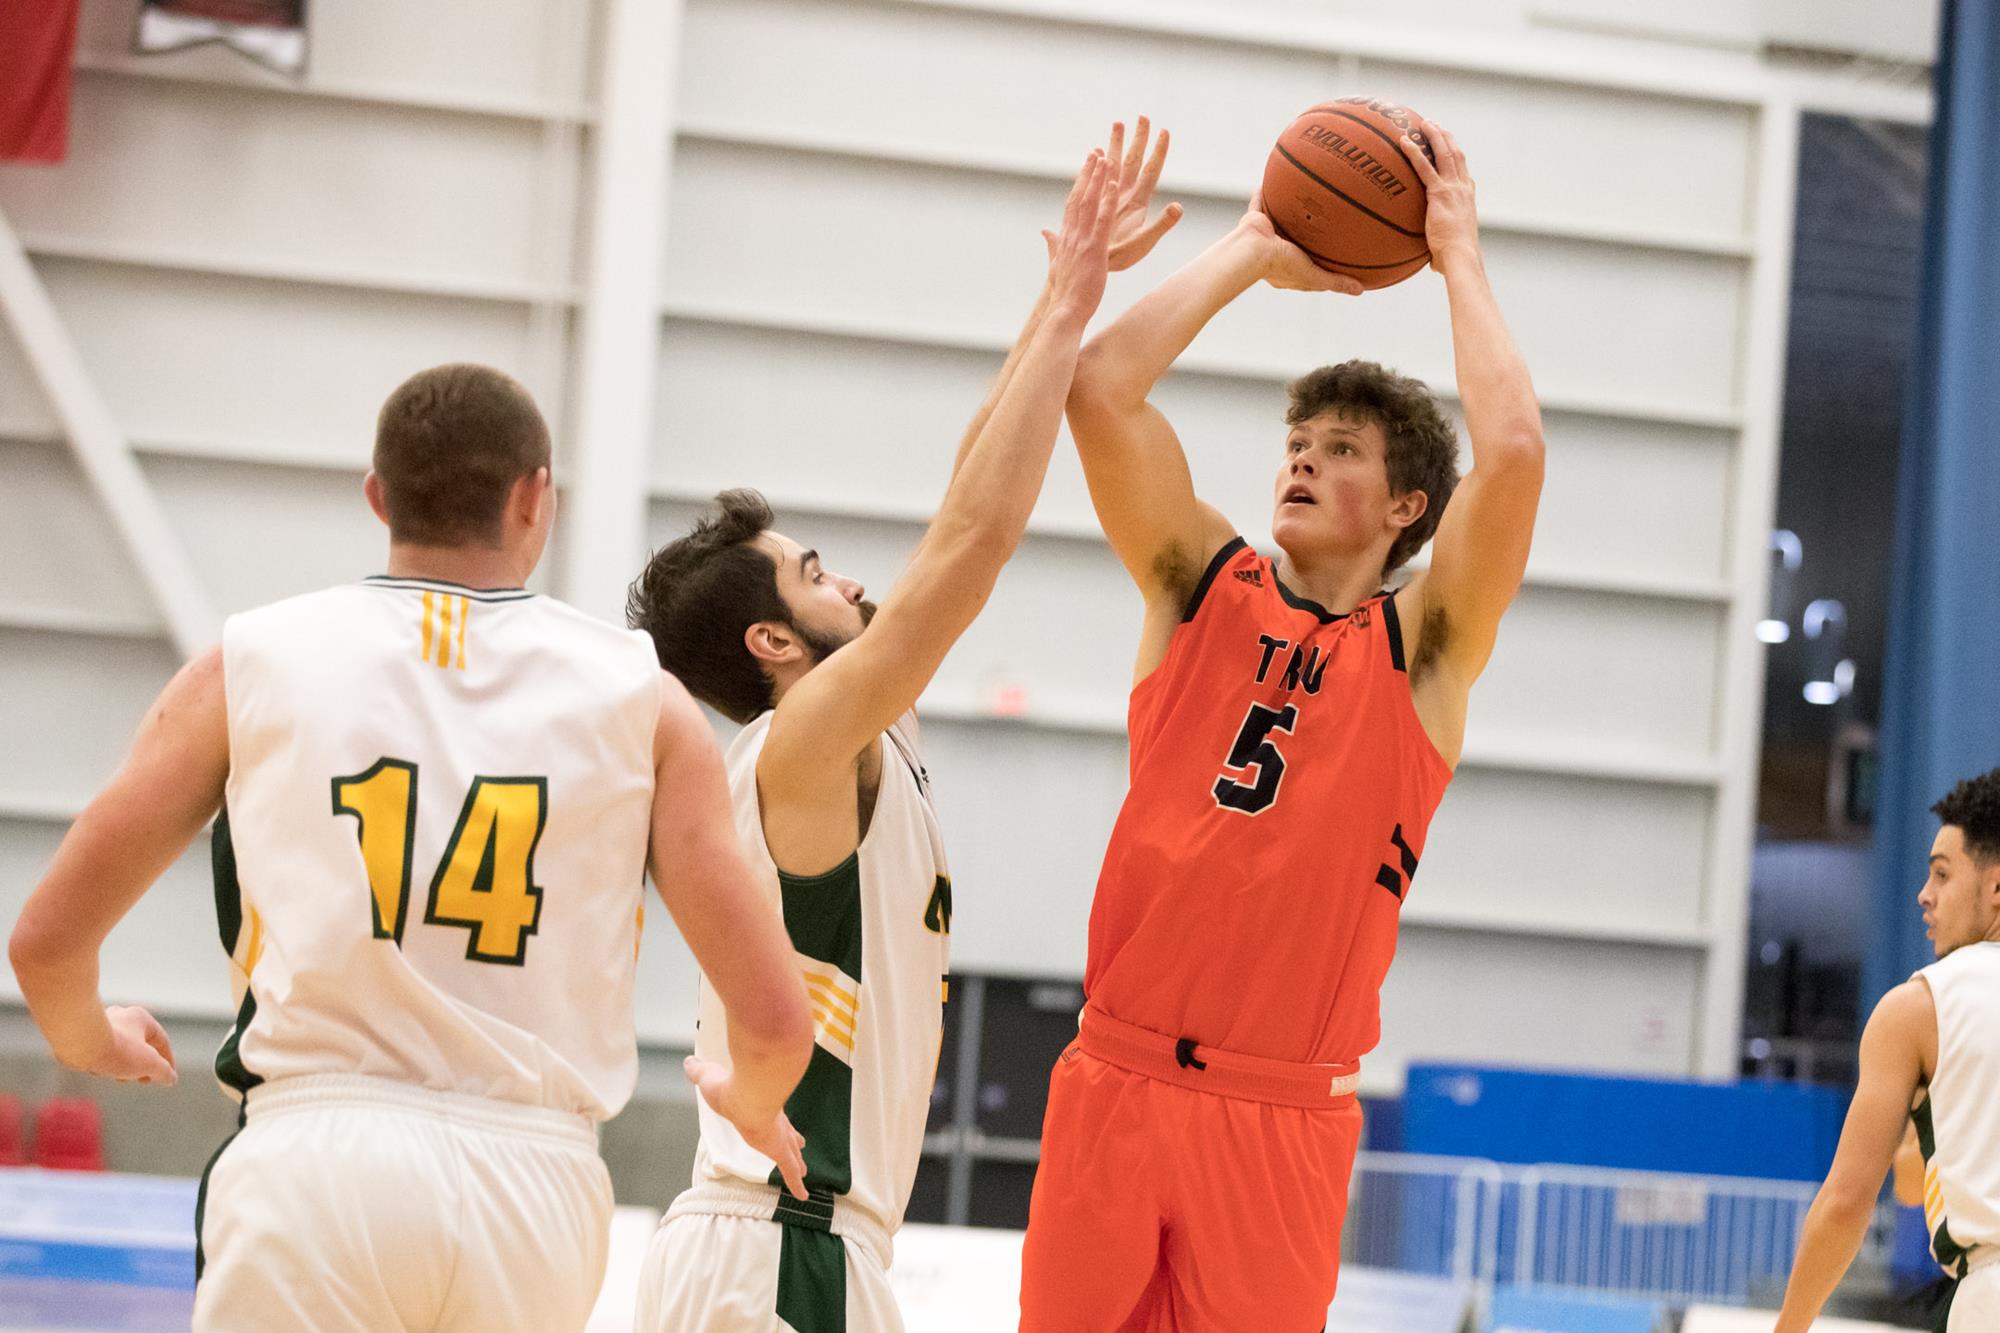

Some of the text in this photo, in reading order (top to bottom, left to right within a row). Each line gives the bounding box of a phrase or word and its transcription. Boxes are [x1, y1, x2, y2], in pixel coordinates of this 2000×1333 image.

[1301, 125, 1407, 197] EVOLUTION
[1255, 633, 1331, 695] TRU
[1211, 701, 1299, 817] 5
[331, 756, 548, 967] 14
